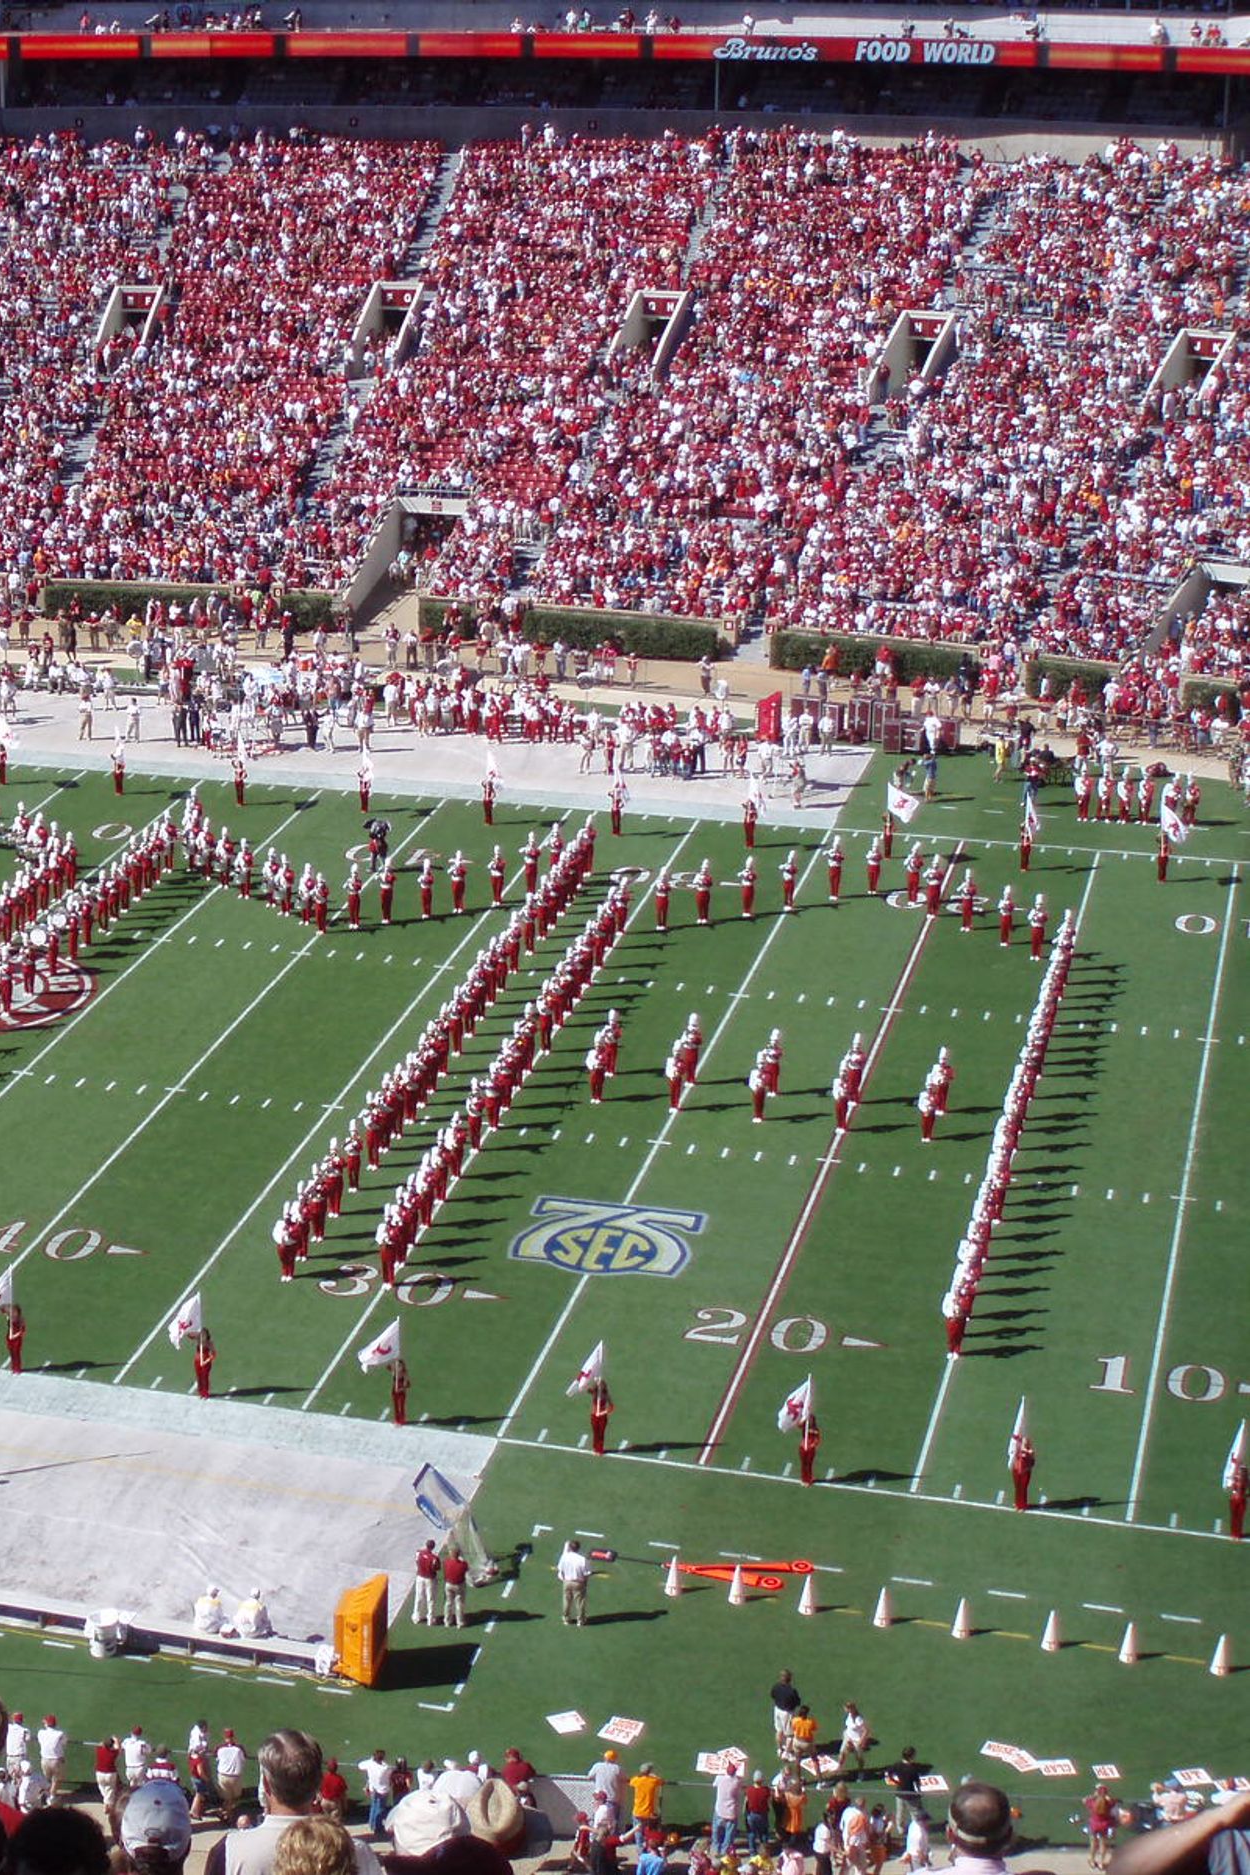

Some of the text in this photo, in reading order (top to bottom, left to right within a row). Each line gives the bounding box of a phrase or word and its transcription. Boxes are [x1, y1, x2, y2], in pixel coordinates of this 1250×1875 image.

[713, 37, 996, 65] Bruno's FOOD WORLD
[552, 1227, 652, 1271] SEC
[317, 1264, 456, 1306] 30
[683, 1306, 830, 1353] 20
[1088, 1354, 1227, 1402] 10
